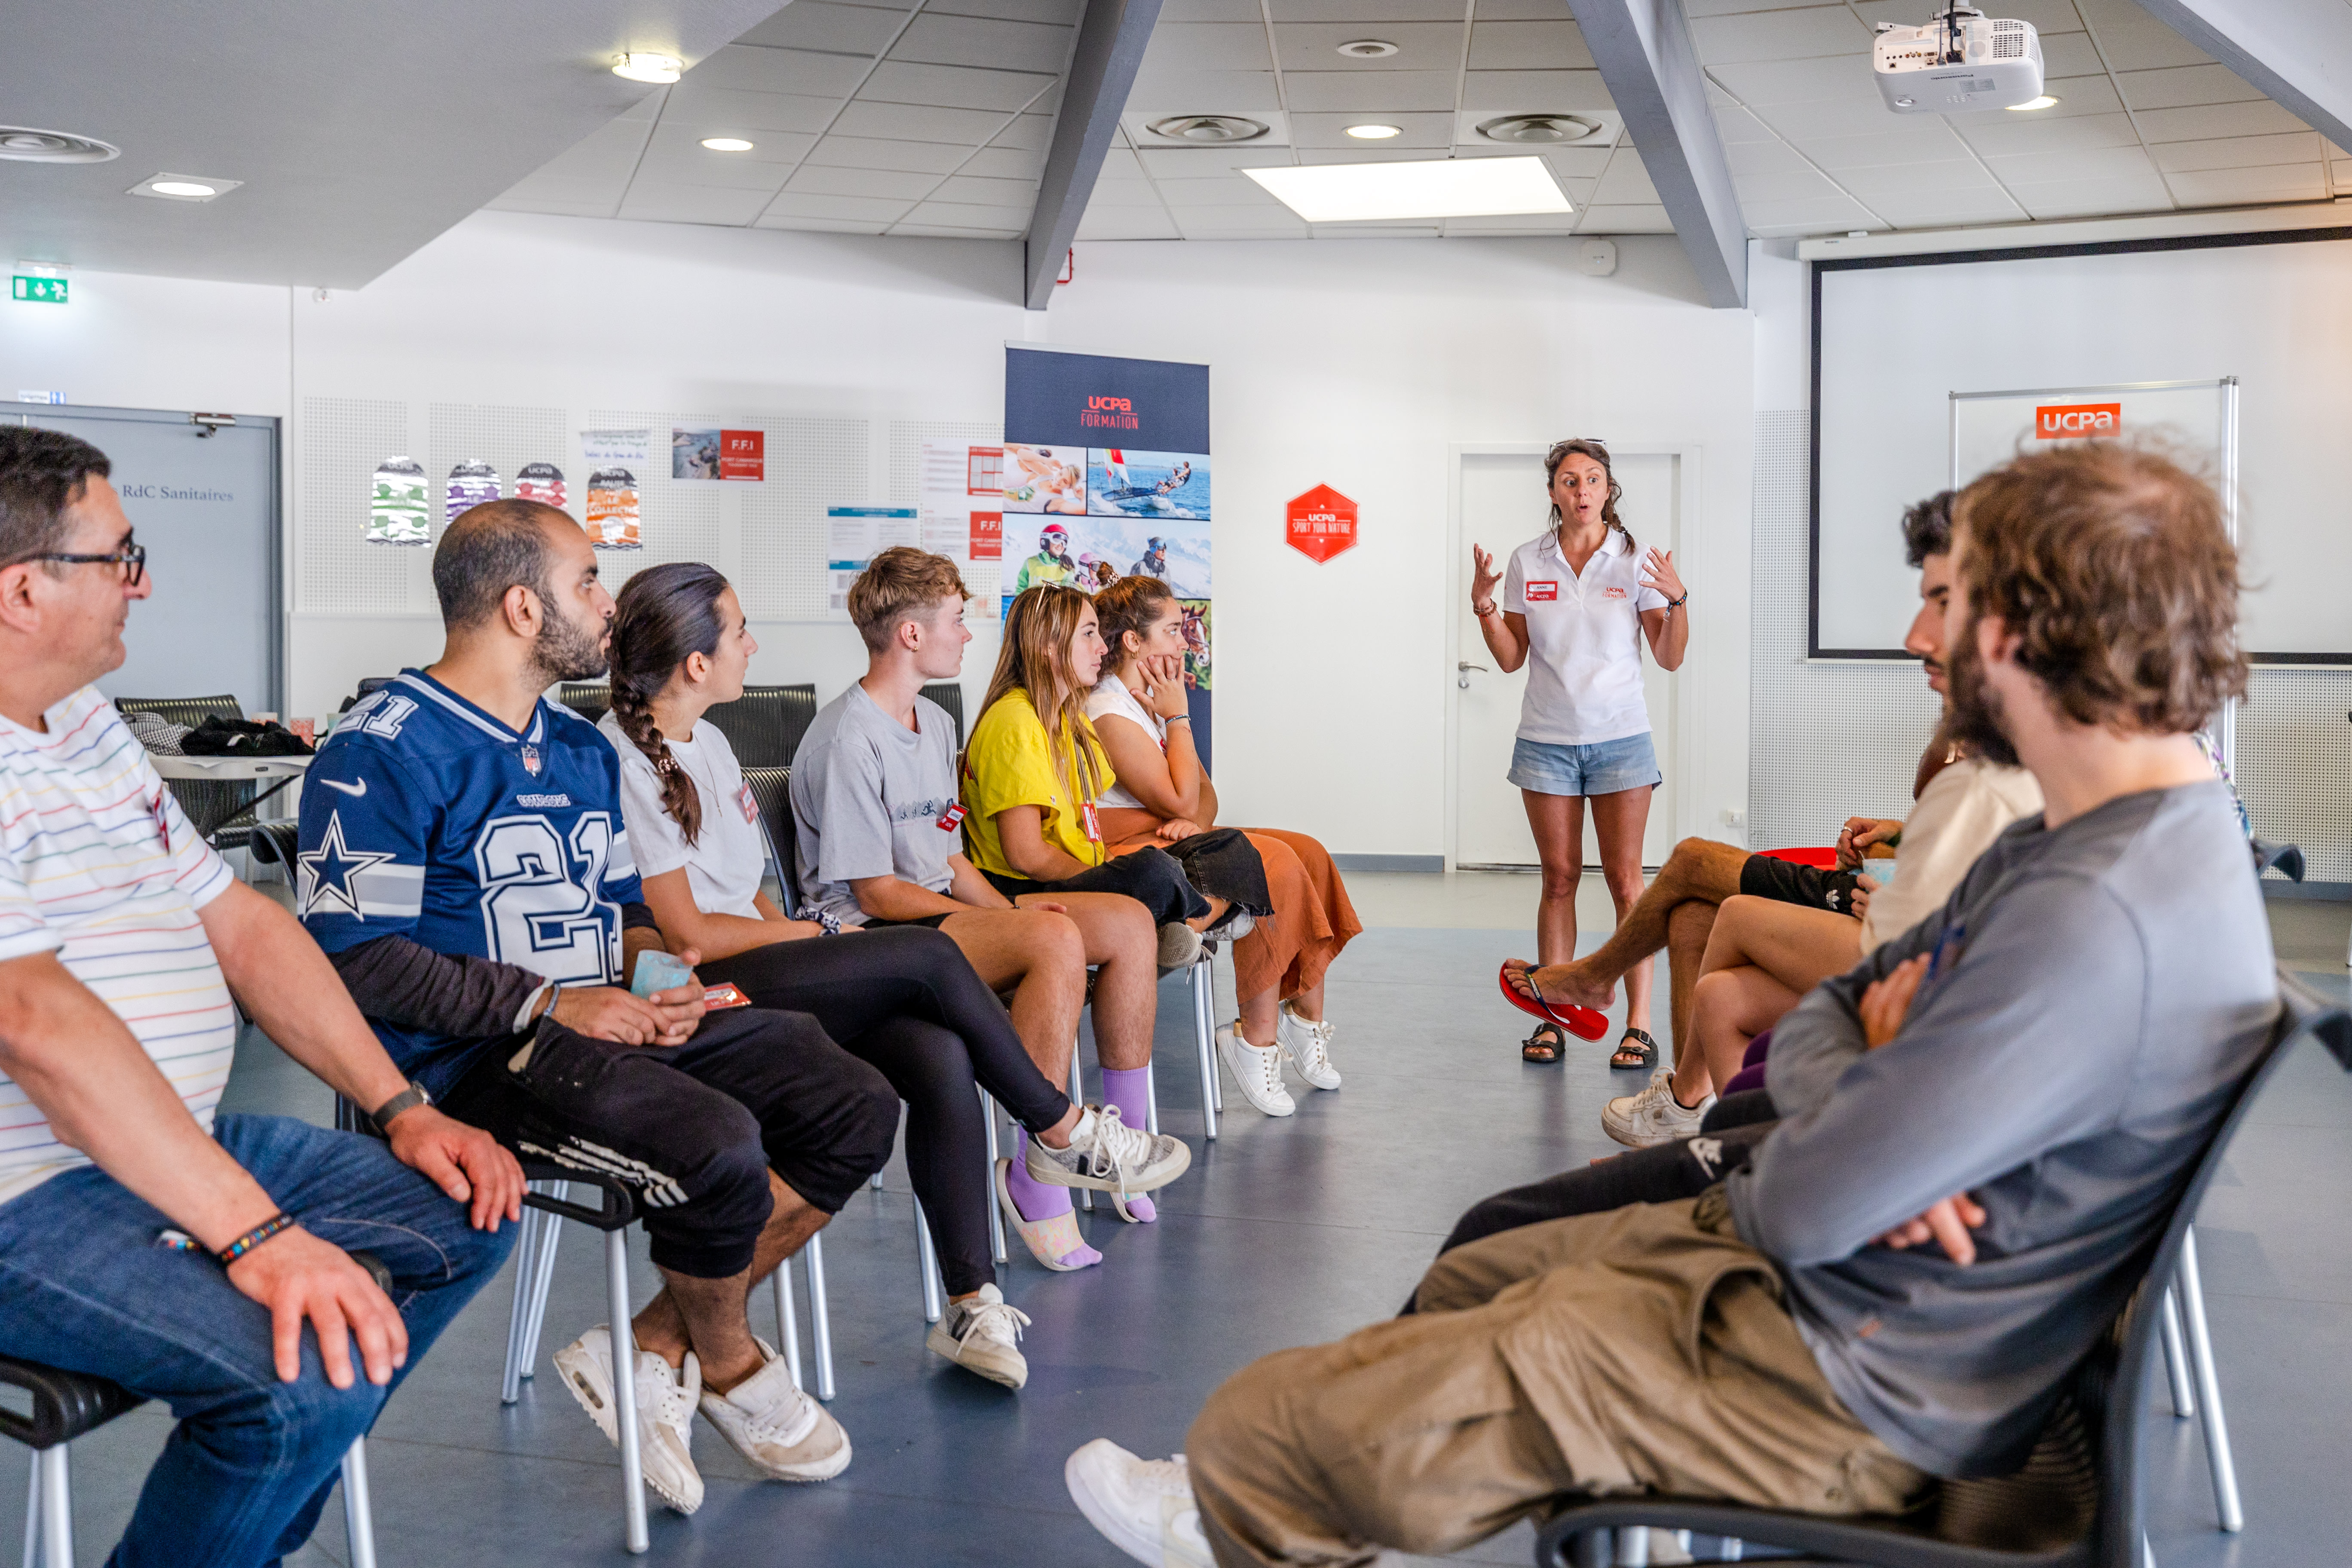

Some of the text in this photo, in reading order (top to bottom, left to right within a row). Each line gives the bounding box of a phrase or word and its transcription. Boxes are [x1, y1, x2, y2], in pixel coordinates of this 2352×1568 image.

[1081, 413, 1138, 429] FORMATION
[123, 485, 234, 501] RdC Sanitaires
[1292, 522, 1351, 533] SPORT YOUR NATURE
[474, 811, 623, 987] 21
